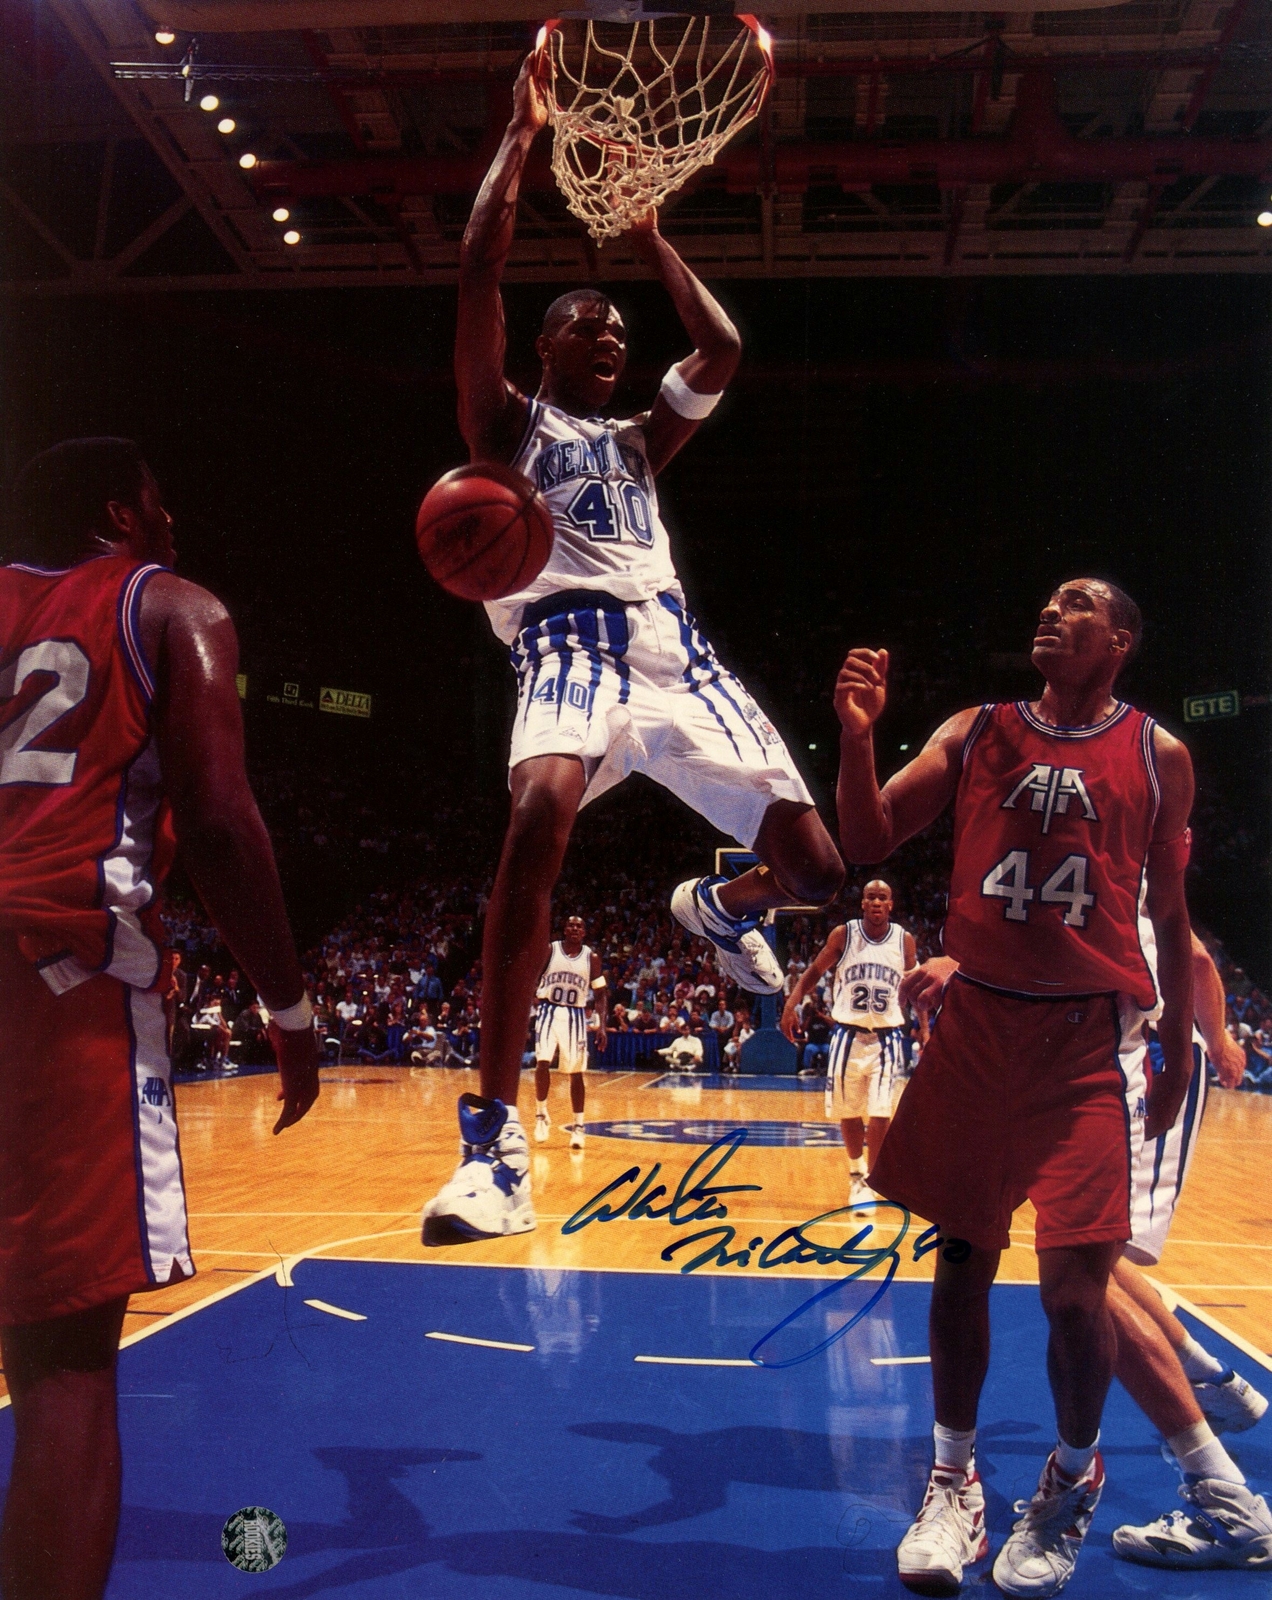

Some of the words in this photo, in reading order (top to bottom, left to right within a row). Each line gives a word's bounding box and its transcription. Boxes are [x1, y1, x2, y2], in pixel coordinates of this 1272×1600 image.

[567, 479, 655, 549] 40
[0, 636, 91, 787] 2
[335, 691, 370, 709] DELTA
[531, 675, 590, 713] 40
[1190, 696, 1231, 717] GTE
[980, 848, 1096, 929] 44
[844, 961, 901, 991] KENTUCKY
[552, 987, 578, 1005] 00
[850, 983, 891, 1015] 25
[243, 1519, 262, 1560] ROOKIES
